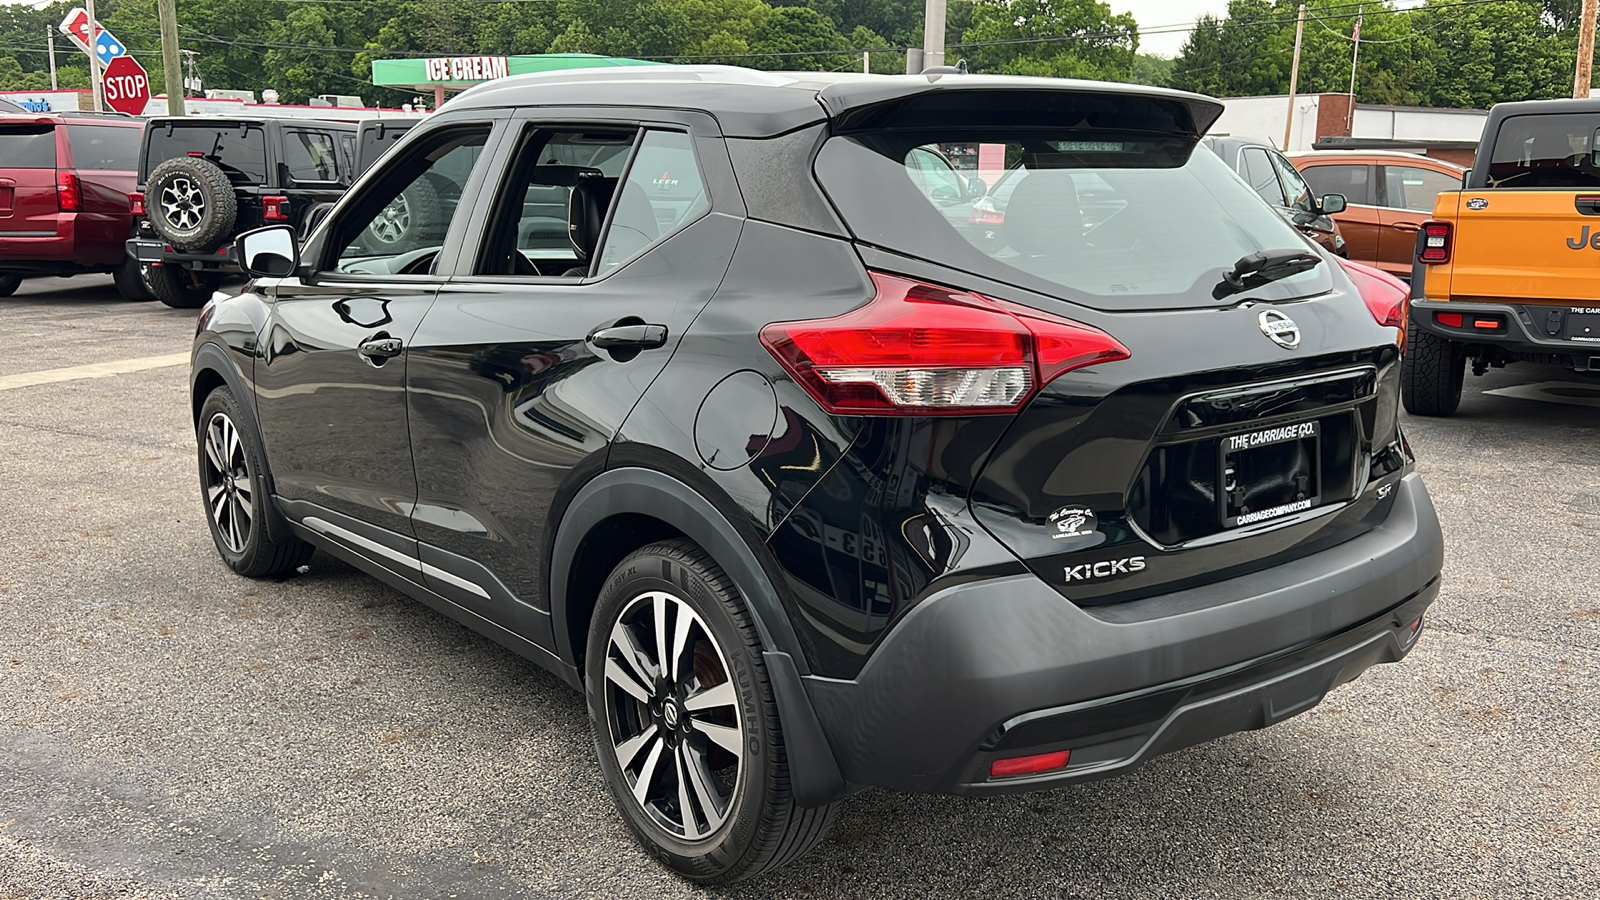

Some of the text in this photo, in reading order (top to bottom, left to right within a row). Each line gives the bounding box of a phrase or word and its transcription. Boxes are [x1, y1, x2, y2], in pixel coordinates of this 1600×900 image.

[425, 56, 509, 81] ICE CREAM
[106, 74, 146, 100] STOP
[1268, 320, 1297, 331] NISSAN
[1230, 422, 1315, 449] THE CARRIAGE CO.
[1376, 483, 1392, 500] SR
[1236, 499, 1312, 525] CARRIAGECOMPANY.COM
[1063, 556, 1147, 582] KICKS
[730, 648, 760, 756] KUMHO
